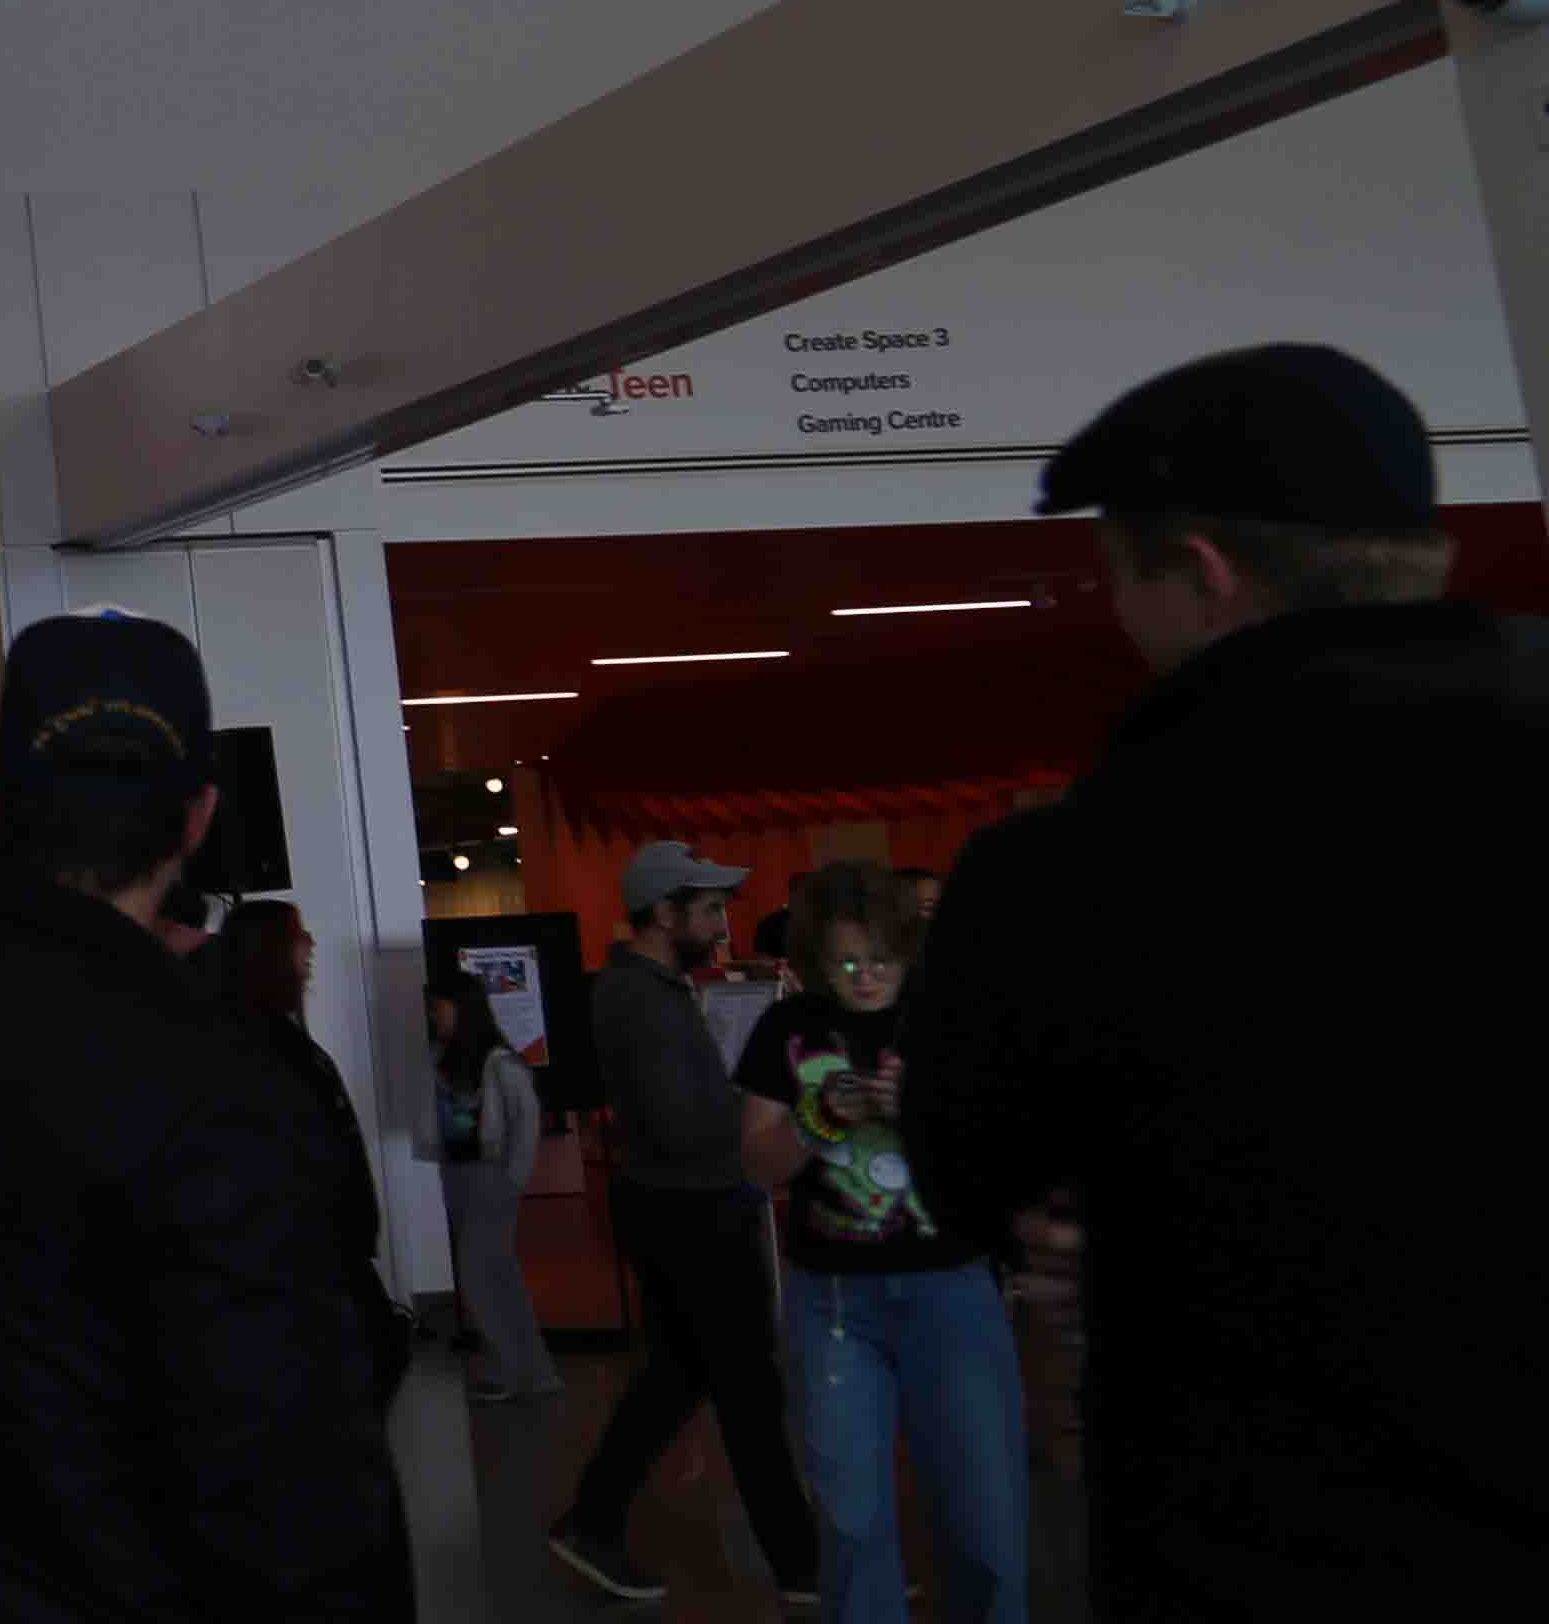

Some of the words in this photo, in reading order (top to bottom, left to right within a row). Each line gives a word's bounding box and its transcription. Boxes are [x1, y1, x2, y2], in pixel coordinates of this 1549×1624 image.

[785, 331, 857, 352] Create
[862, 330, 929, 353] Space
[933, 327, 949, 347] 3
[612, 365, 693, 400] Teen
[791, 373, 911, 395] Computers
[798, 413, 882, 435] Gaming
[888, 410, 962, 429] Centre
